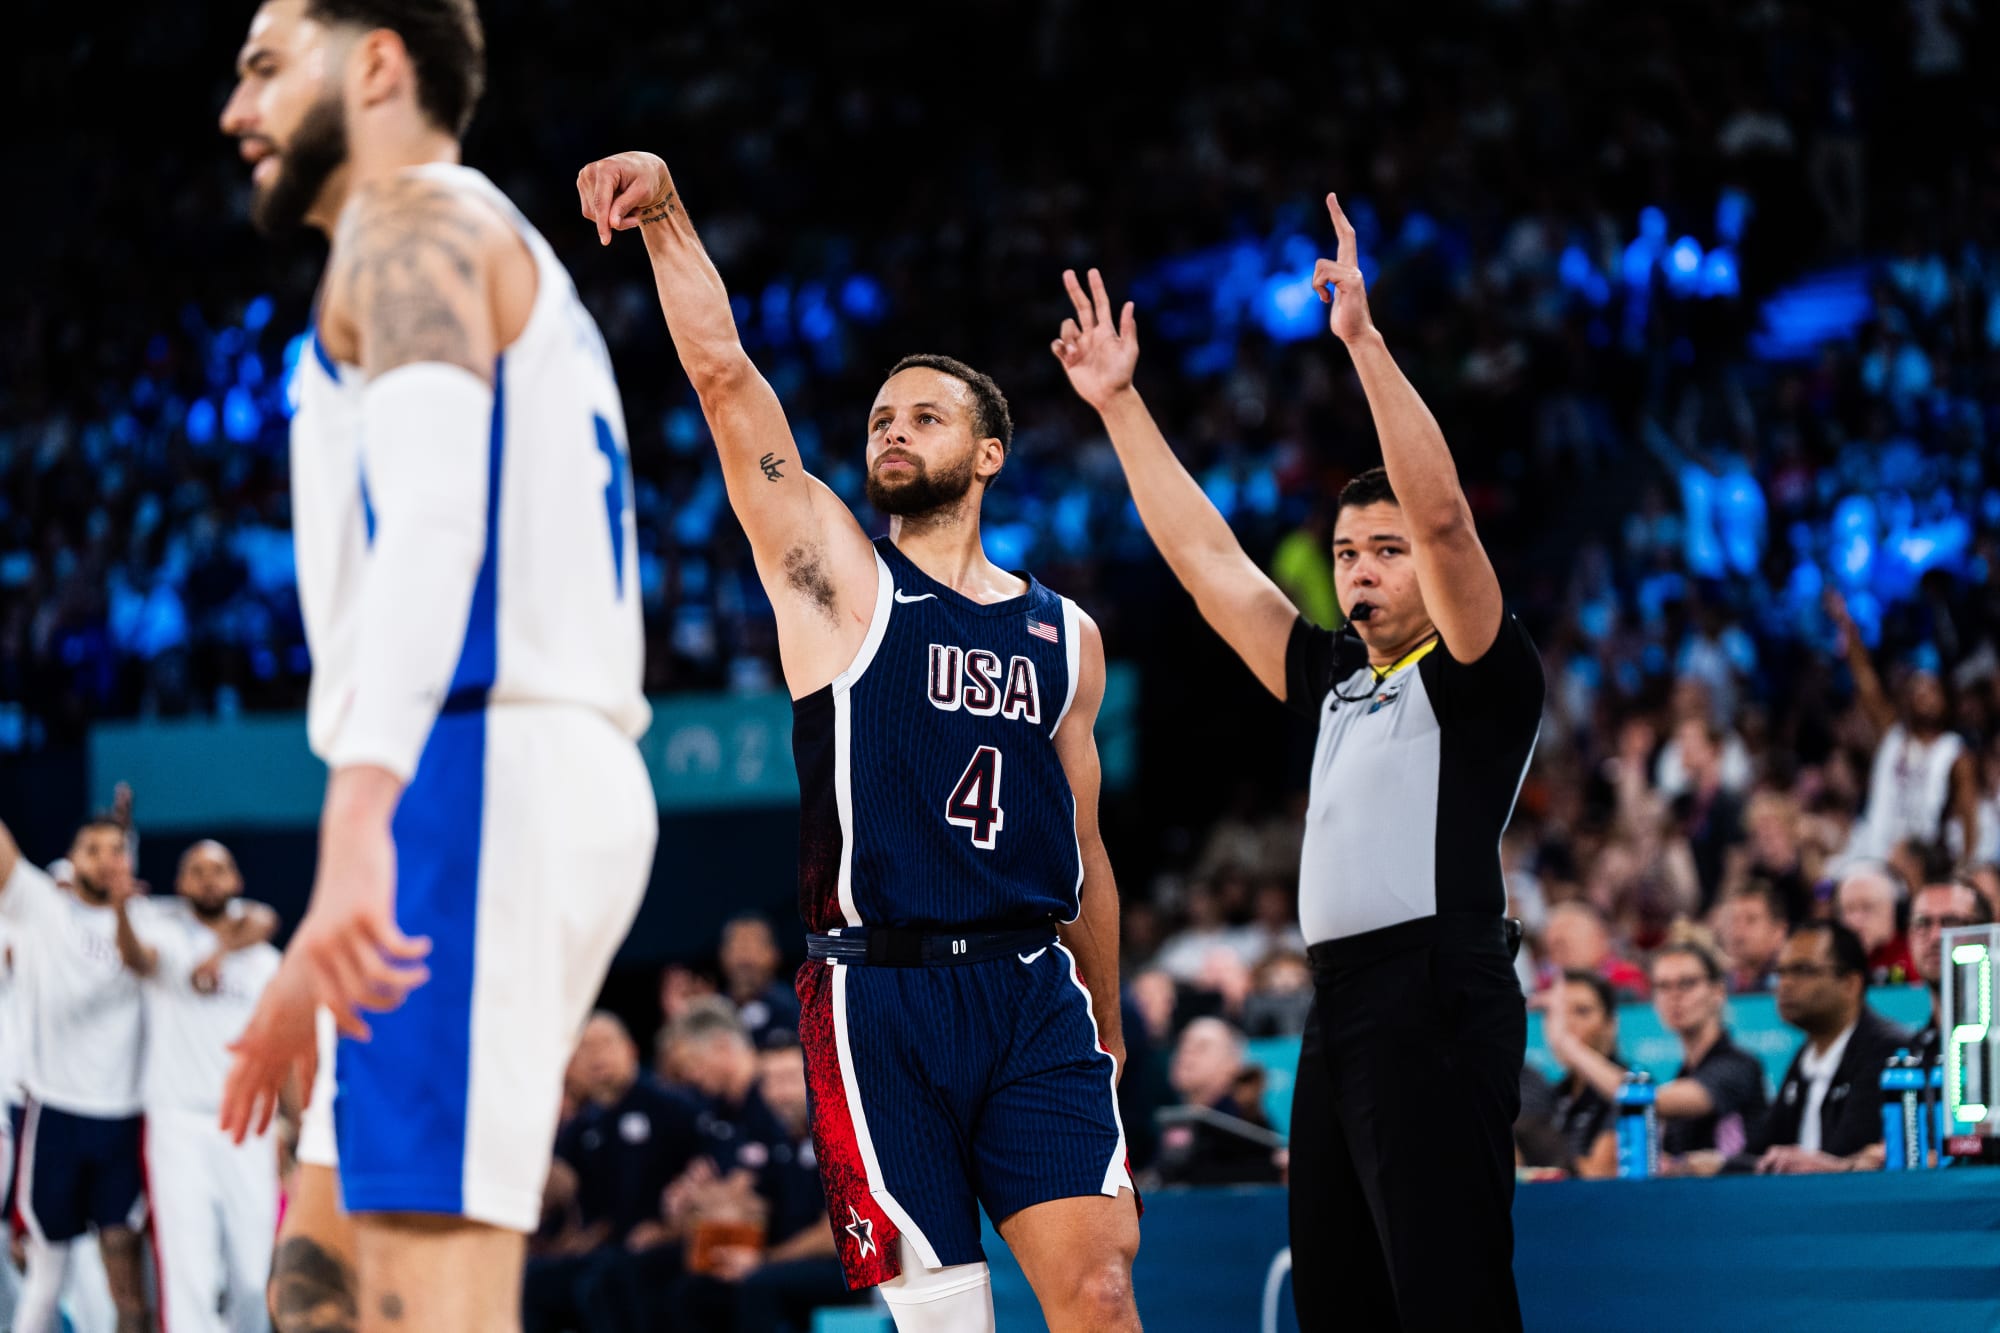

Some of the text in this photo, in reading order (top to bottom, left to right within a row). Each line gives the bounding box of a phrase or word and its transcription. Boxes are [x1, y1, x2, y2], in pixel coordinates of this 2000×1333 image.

[928, 643, 1041, 724] USA
[945, 745, 1004, 850] 4
[1951, 944, 1991, 1122] 2
